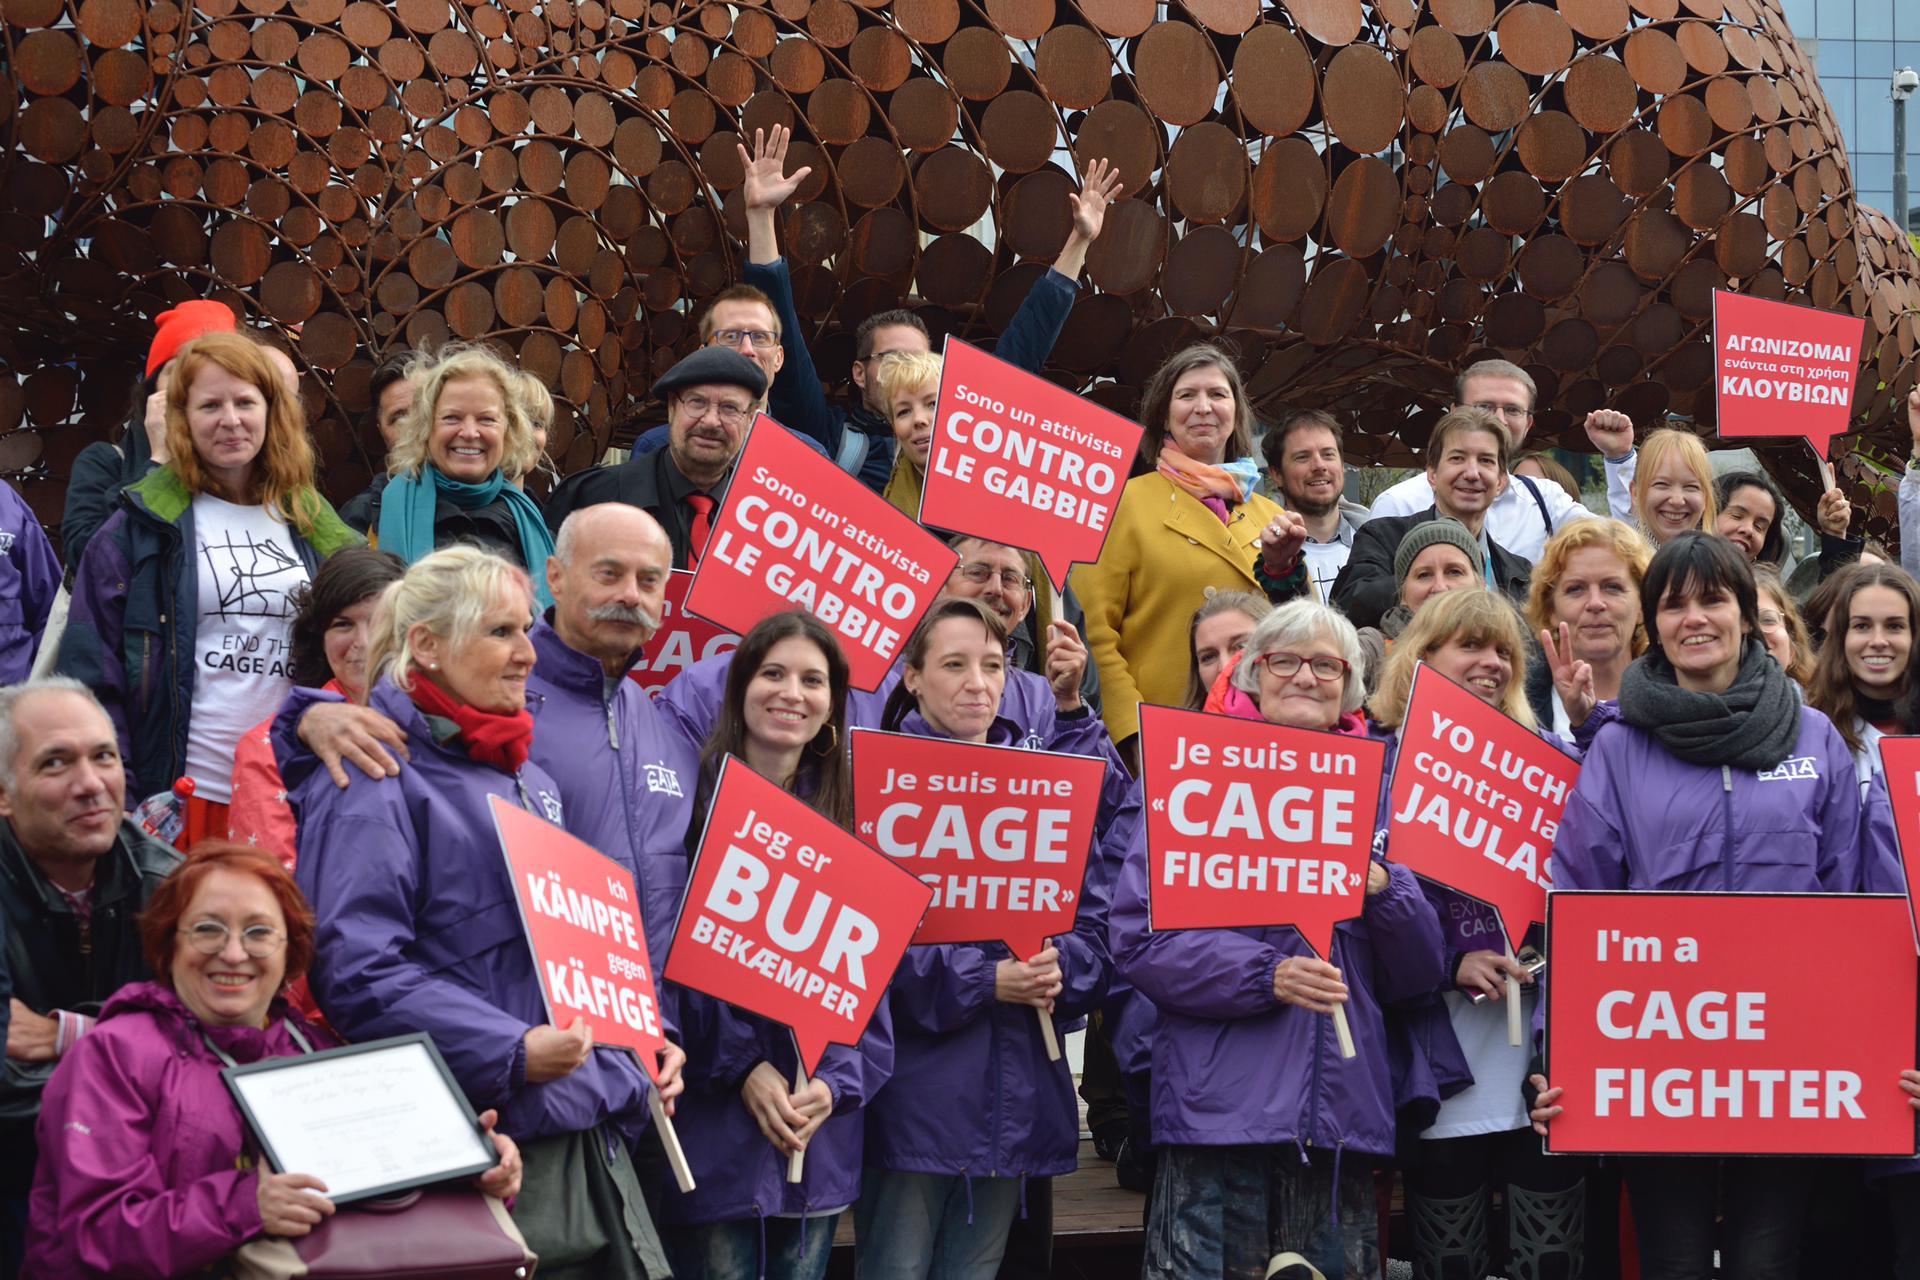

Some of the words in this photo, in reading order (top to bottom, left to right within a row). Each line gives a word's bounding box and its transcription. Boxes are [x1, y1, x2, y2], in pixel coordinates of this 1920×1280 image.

[1724, 357, 1778, 373] ενάντια
[1780, 364, 1804, 377] στη
[1807, 366, 1849, 382] χρήση
[1725, 334, 1852, 362] ΑΓΩΝΙΖΟΜΑΙ
[1722, 376, 1849, 406] ΚΛΟΥΒΙΩΝ
[954, 384, 1005, 414] Sono
[1009, 406, 1036, 426] un
[1040, 417, 1123, 459] attivista
[946, 411, 1115, 495] CONTRO
[934, 447, 977, 484] LE
[983, 466, 1109, 532] GABBIE
[752, 466, 807, 508] Sono
[810, 503, 931, 584] un'attivista
[735, 495, 917, 620] CONTRO
[712, 530, 762, 577] LE
[765, 563, 901, 660] GABBIE
[204, 651, 265, 674] CAGE
[269, 661, 297, 679] AG
[222, 635, 260, 653] END
[267, 638, 293, 657] TH
[880, 768, 917, 795] Je
[927, 771, 997, 794] suis
[1007, 777, 1073, 796] une
[1170, 737, 1211, 770] Je
[1222, 742, 1298, 771] suis
[1309, 752, 1356, 776] un
[1431, 710, 1475, 753] YO
[1480, 740, 1574, 806] LUCH
[1414, 751, 1523, 823] contra
[1530, 807, 1559, 842] la
[734, 810, 793, 860] Jeg
[796, 844, 832, 873] er
[526, 870, 640, 951] KÄMPFE
[607, 876, 628, 903] Ich
[704, 844, 880, 991] BUR
[1460, 916, 1500, 937] CAG
[1597, 929, 1662, 962] I'm
[1674, 936, 1698, 962] a
[607, 952, 647, 982] gegen
[690, 915, 860, 1022] BEKÆMPER
[545, 956, 660, 1037] KÄFIGE
[1596, 990, 1766, 1040] CAGE
[1595, 1068, 1867, 1119] FIGHTER
